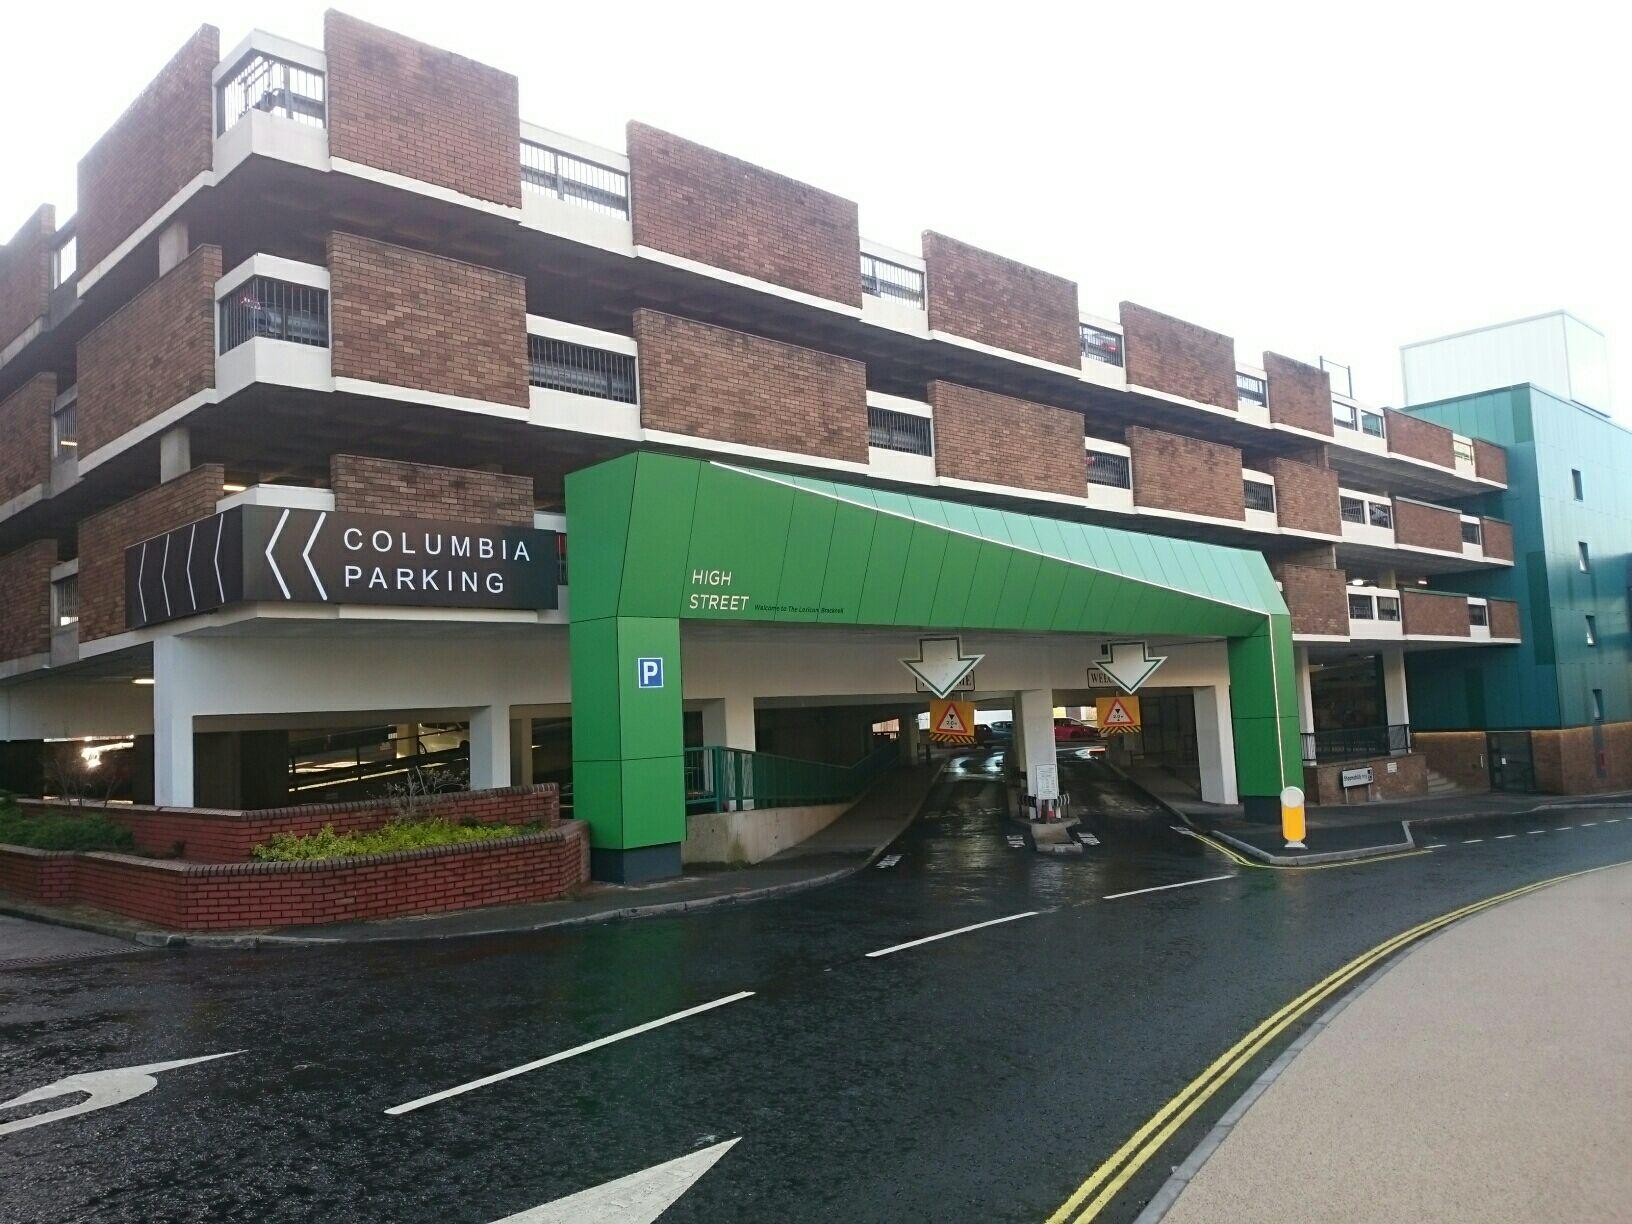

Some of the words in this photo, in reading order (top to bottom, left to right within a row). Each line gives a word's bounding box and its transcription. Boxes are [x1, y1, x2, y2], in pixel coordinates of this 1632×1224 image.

[343, 527, 530, 562] COLUMBIA
[344, 565, 504, 594] PARKING
[691, 568, 732, 586] HIGH
[689, 593, 750, 611] STREET
[754, 604, 780, 612] Welcome
[643, 661, 659, 685] P
